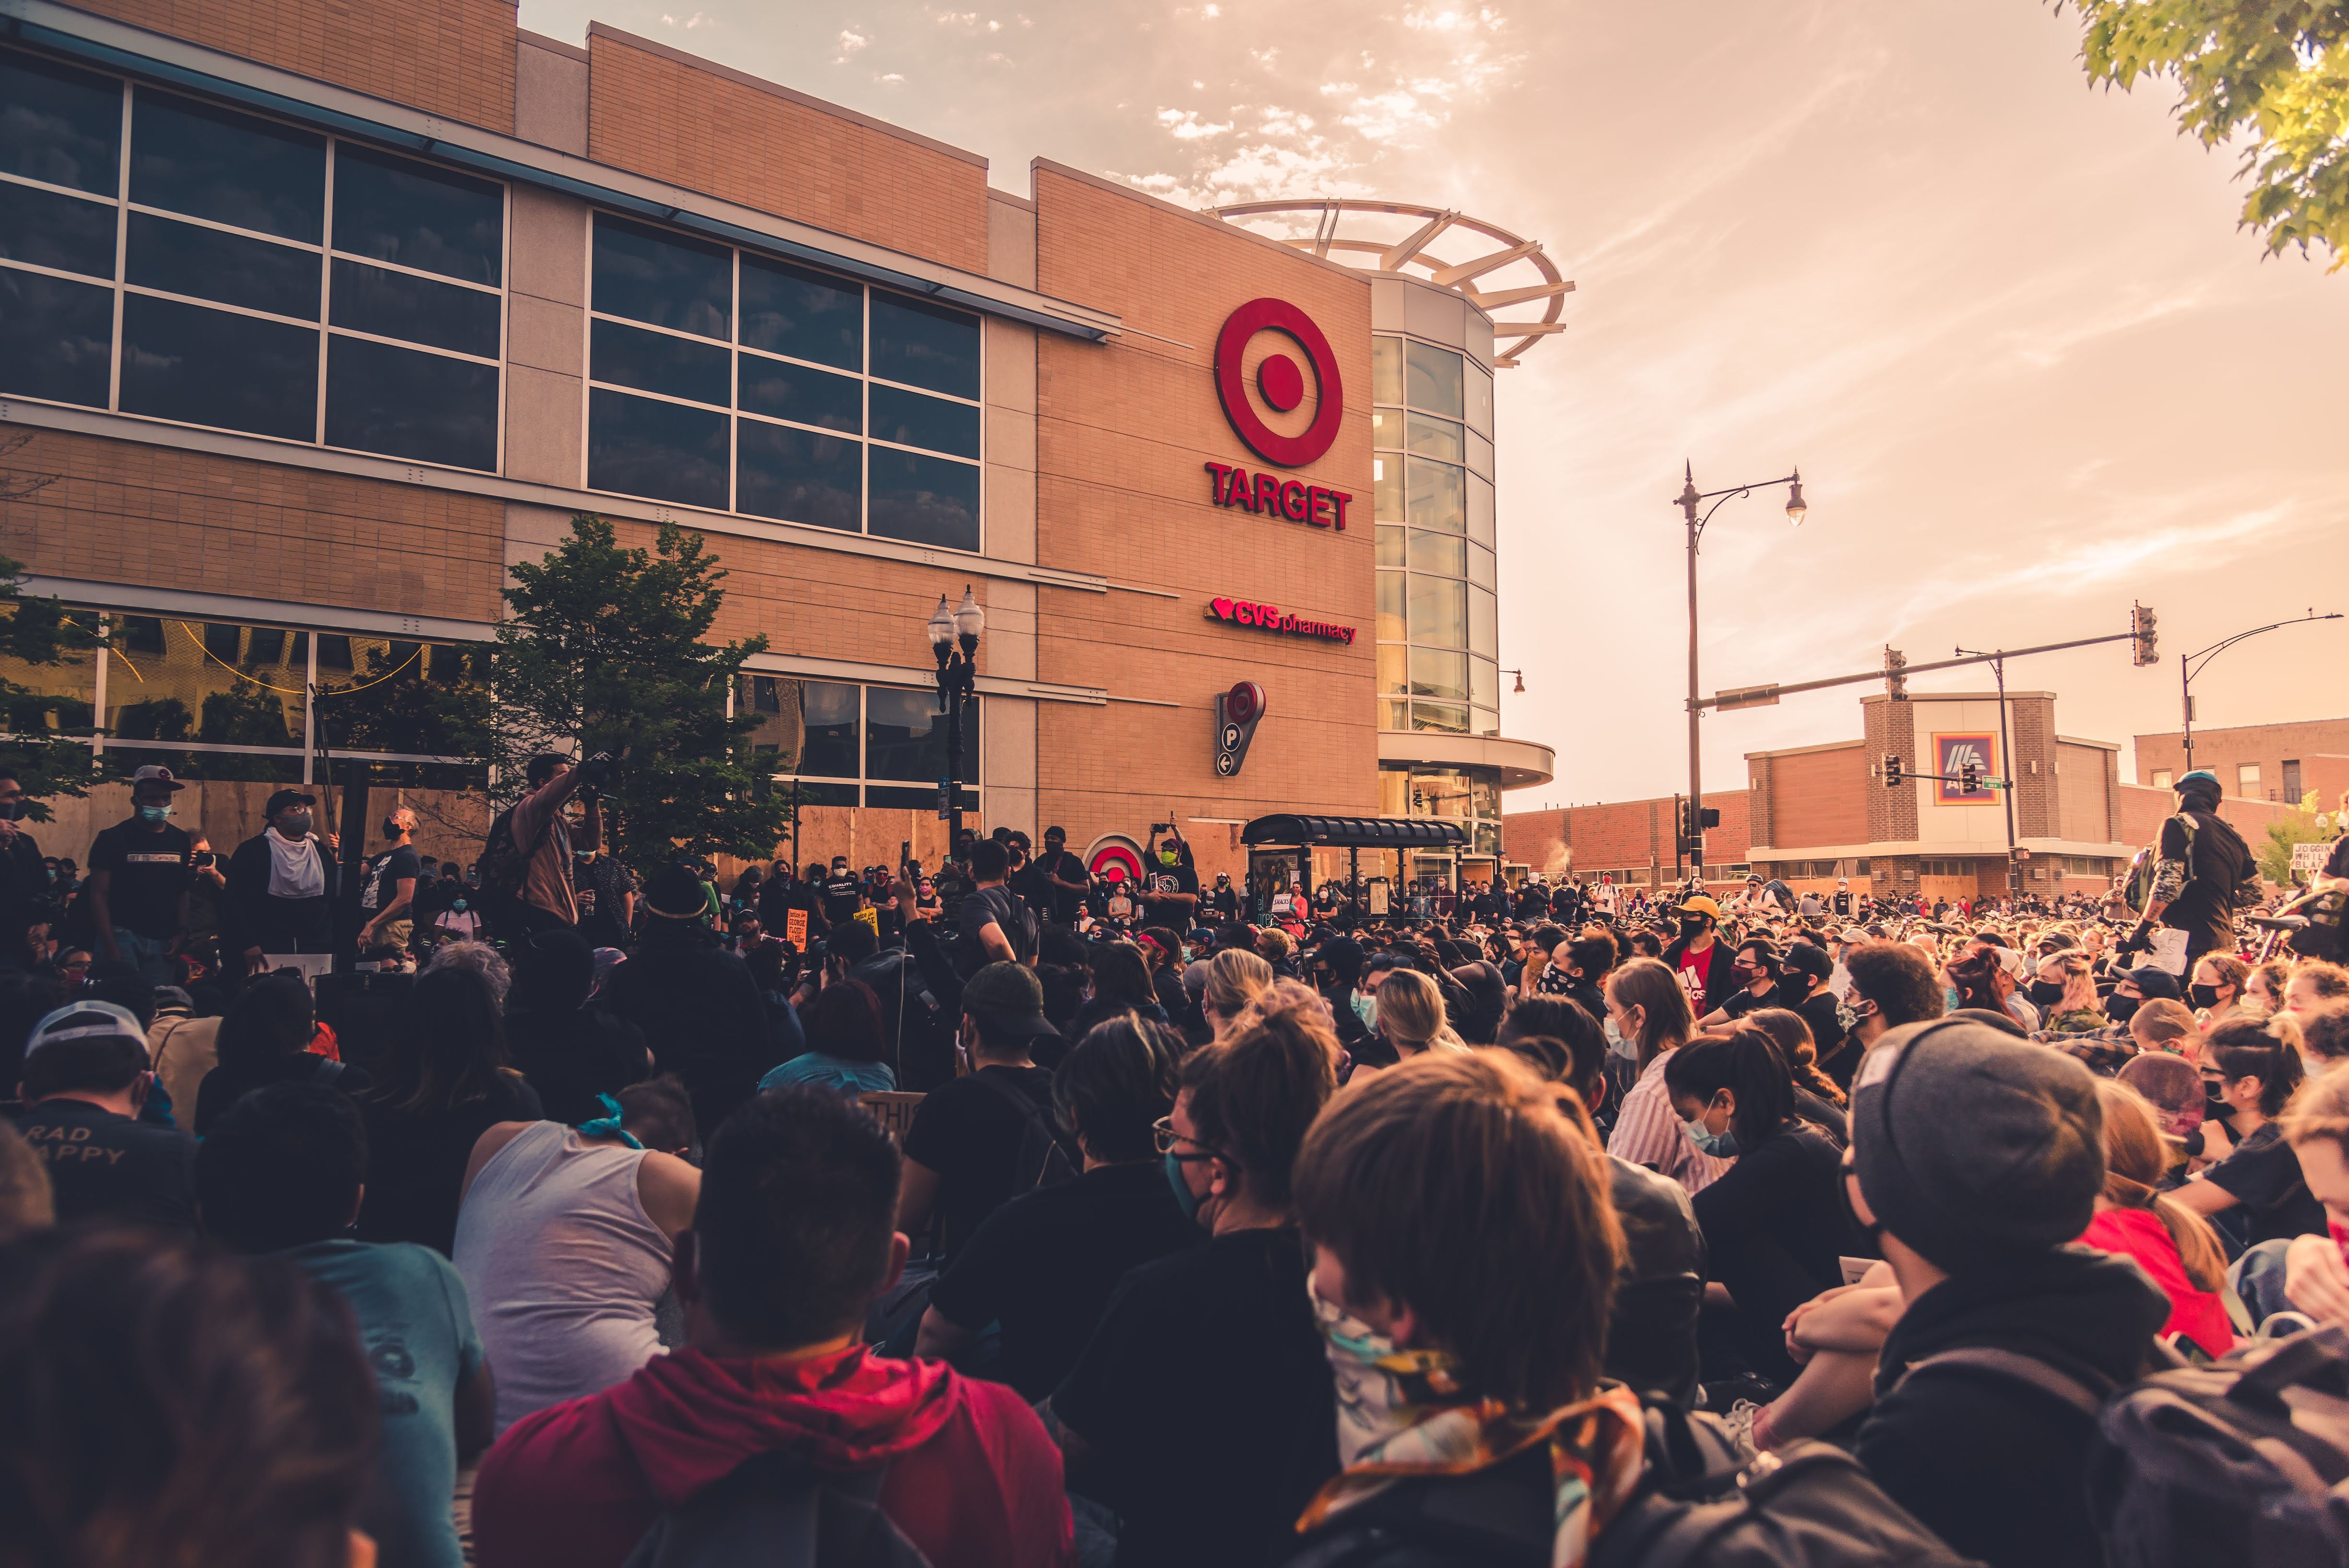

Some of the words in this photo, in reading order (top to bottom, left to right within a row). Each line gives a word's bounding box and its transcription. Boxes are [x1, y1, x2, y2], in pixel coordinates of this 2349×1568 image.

[1205, 462, 1352, 531] TARGET
[1233, 601, 1280, 629] CVS
[1280, 614, 1357, 645] pharmacy
[1226, 729, 1236, 745] P
[1258, 894, 1264, 911] el
[789, 918, 805, 927] GEORGE
